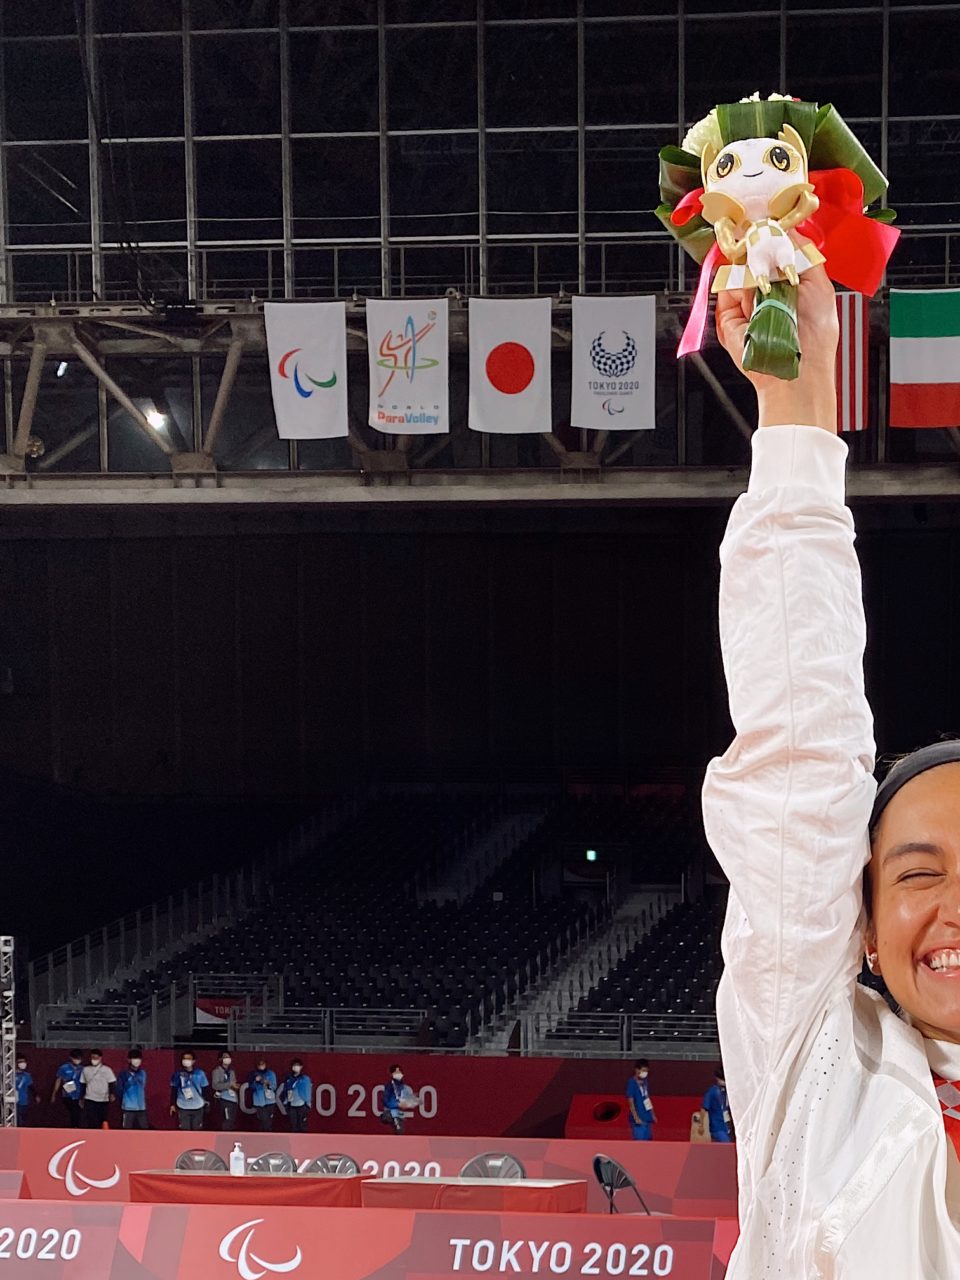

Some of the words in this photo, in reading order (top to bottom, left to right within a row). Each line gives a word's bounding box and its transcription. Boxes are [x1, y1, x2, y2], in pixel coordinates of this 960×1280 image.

[588, 381, 616, 390] TOKYO
[618, 381, 640, 390] 2020
[0, 1227, 81, 1260] 2020
[449, 1239, 572, 1274] TOKYO
[580, 1242, 674, 1277] 2020
